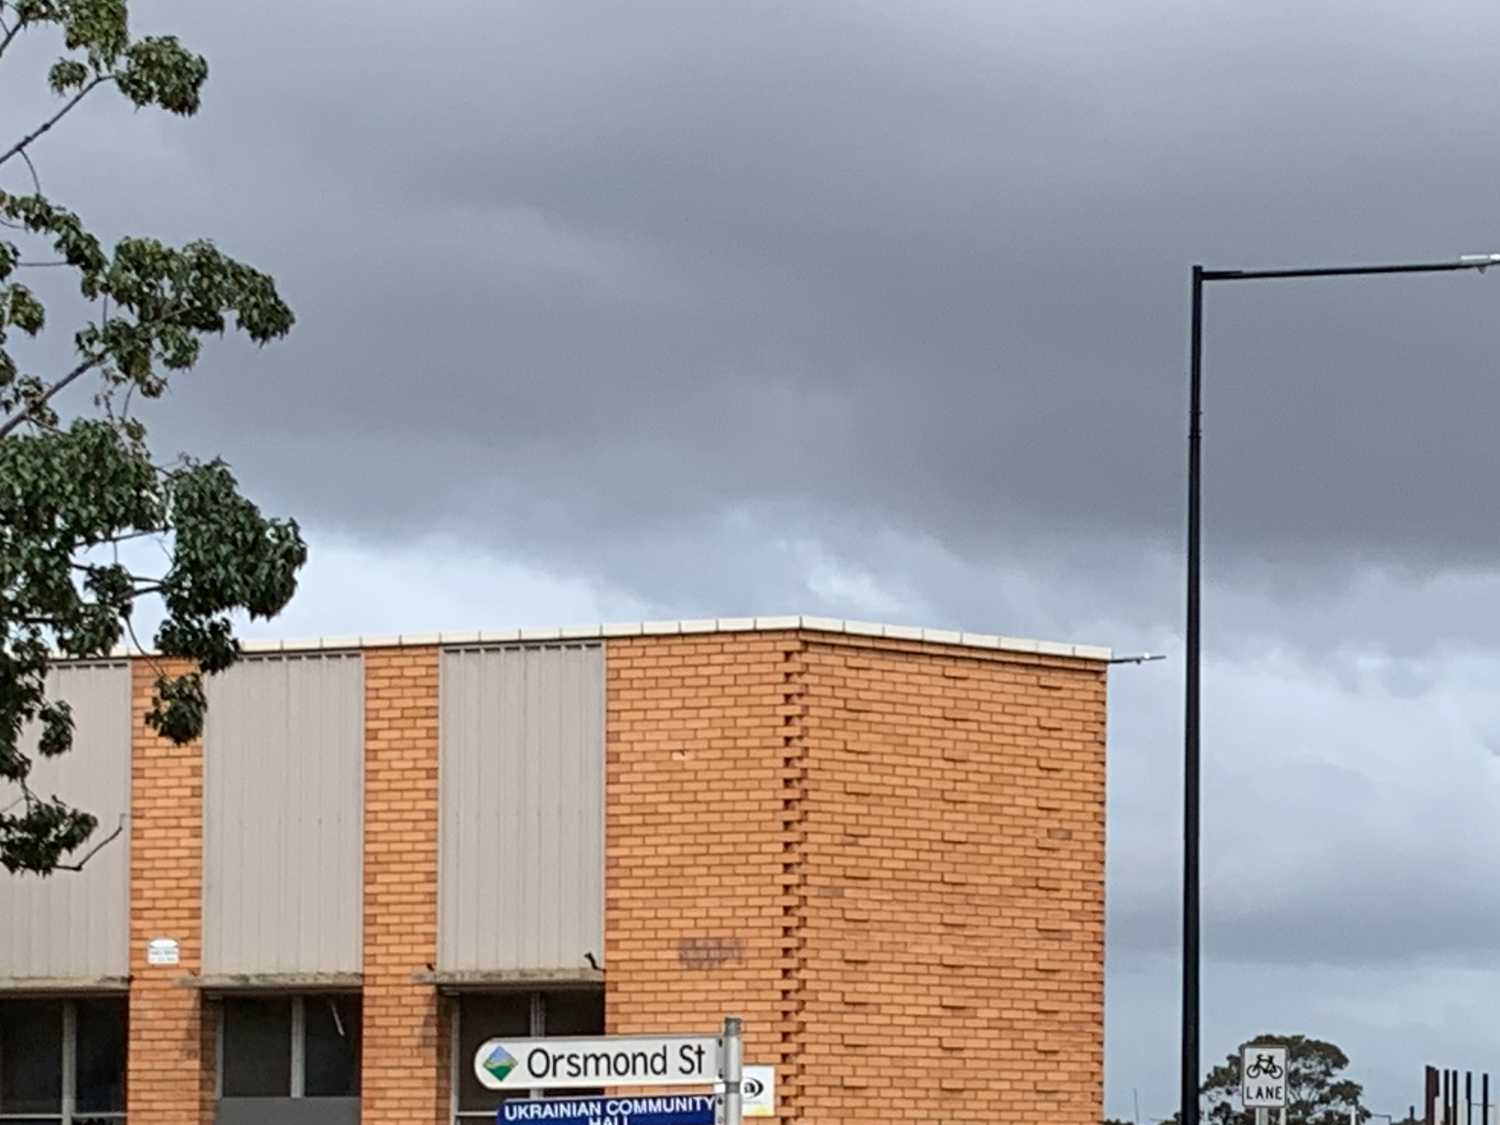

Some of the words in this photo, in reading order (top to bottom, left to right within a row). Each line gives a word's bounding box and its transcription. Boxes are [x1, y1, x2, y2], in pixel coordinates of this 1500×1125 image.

[527, 1045, 667, 1078] Orsmond
[679, 1044, 706, 1074] St
[1246, 1086, 1282, 1100] LANE
[504, 1101, 600, 1121] UKRAINIAN
[606, 1096, 716, 1115] COMMUNITY
